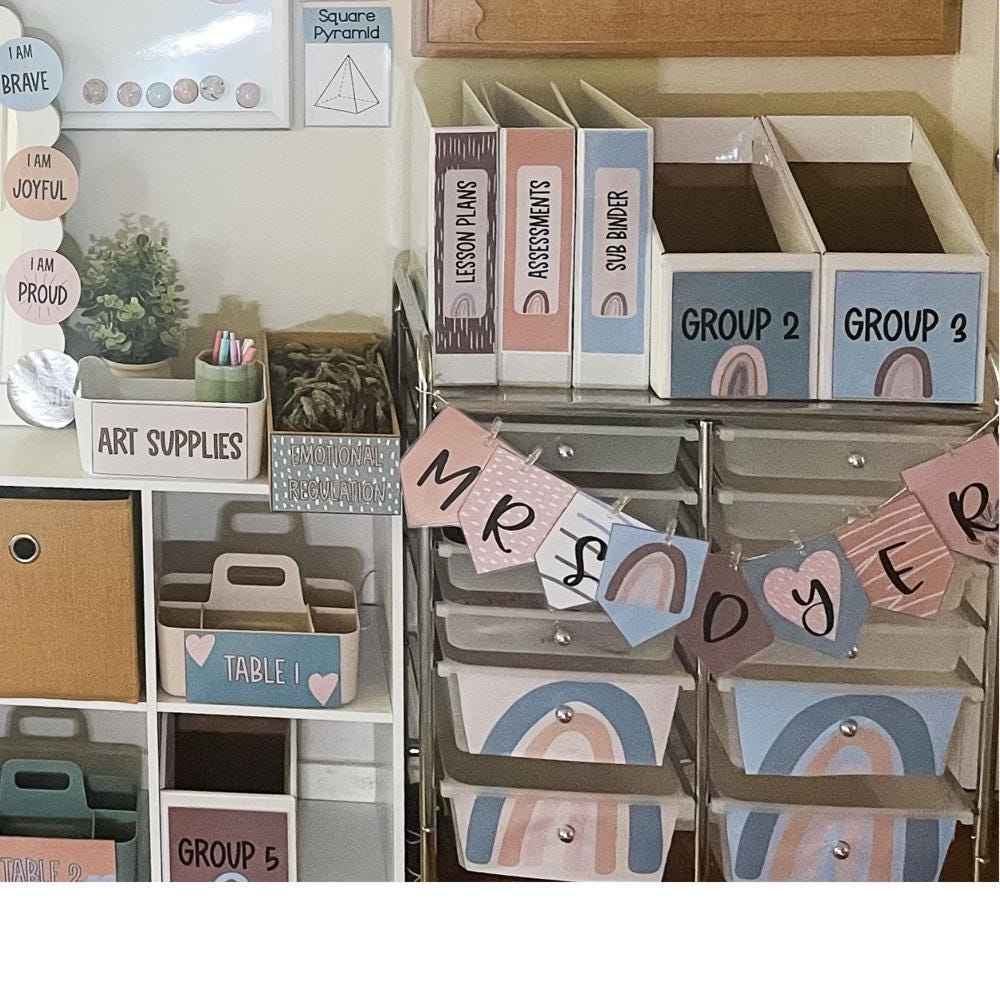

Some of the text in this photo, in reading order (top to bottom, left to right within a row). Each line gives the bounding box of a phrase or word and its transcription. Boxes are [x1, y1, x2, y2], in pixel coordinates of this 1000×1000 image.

[320, 9, 376, 24] Square
[314, 25, 380, 42] Pyramid
[1, 71, 49, 94] BRAVE
[12, 178, 67, 201] JOYFUL
[455, 179, 477, 284] LESSON PLANS
[528, 179, 551, 279] ASSESSMENTS
[606, 190, 628, 272] SUB BINDER
[18, 282, 67, 305] PROUD
[682, 308, 800, 340] GROUP 2
[845, 308, 967, 343] GROUP 3
[98, 427, 243, 459] ART SUPPLIES
[291, 445, 383, 467] EMOTIONAL
[288, 480, 386, 501] REGULATION
[224, 655, 299, 684] TABLE 1
[178, 838, 279, 870] GROUP 5
